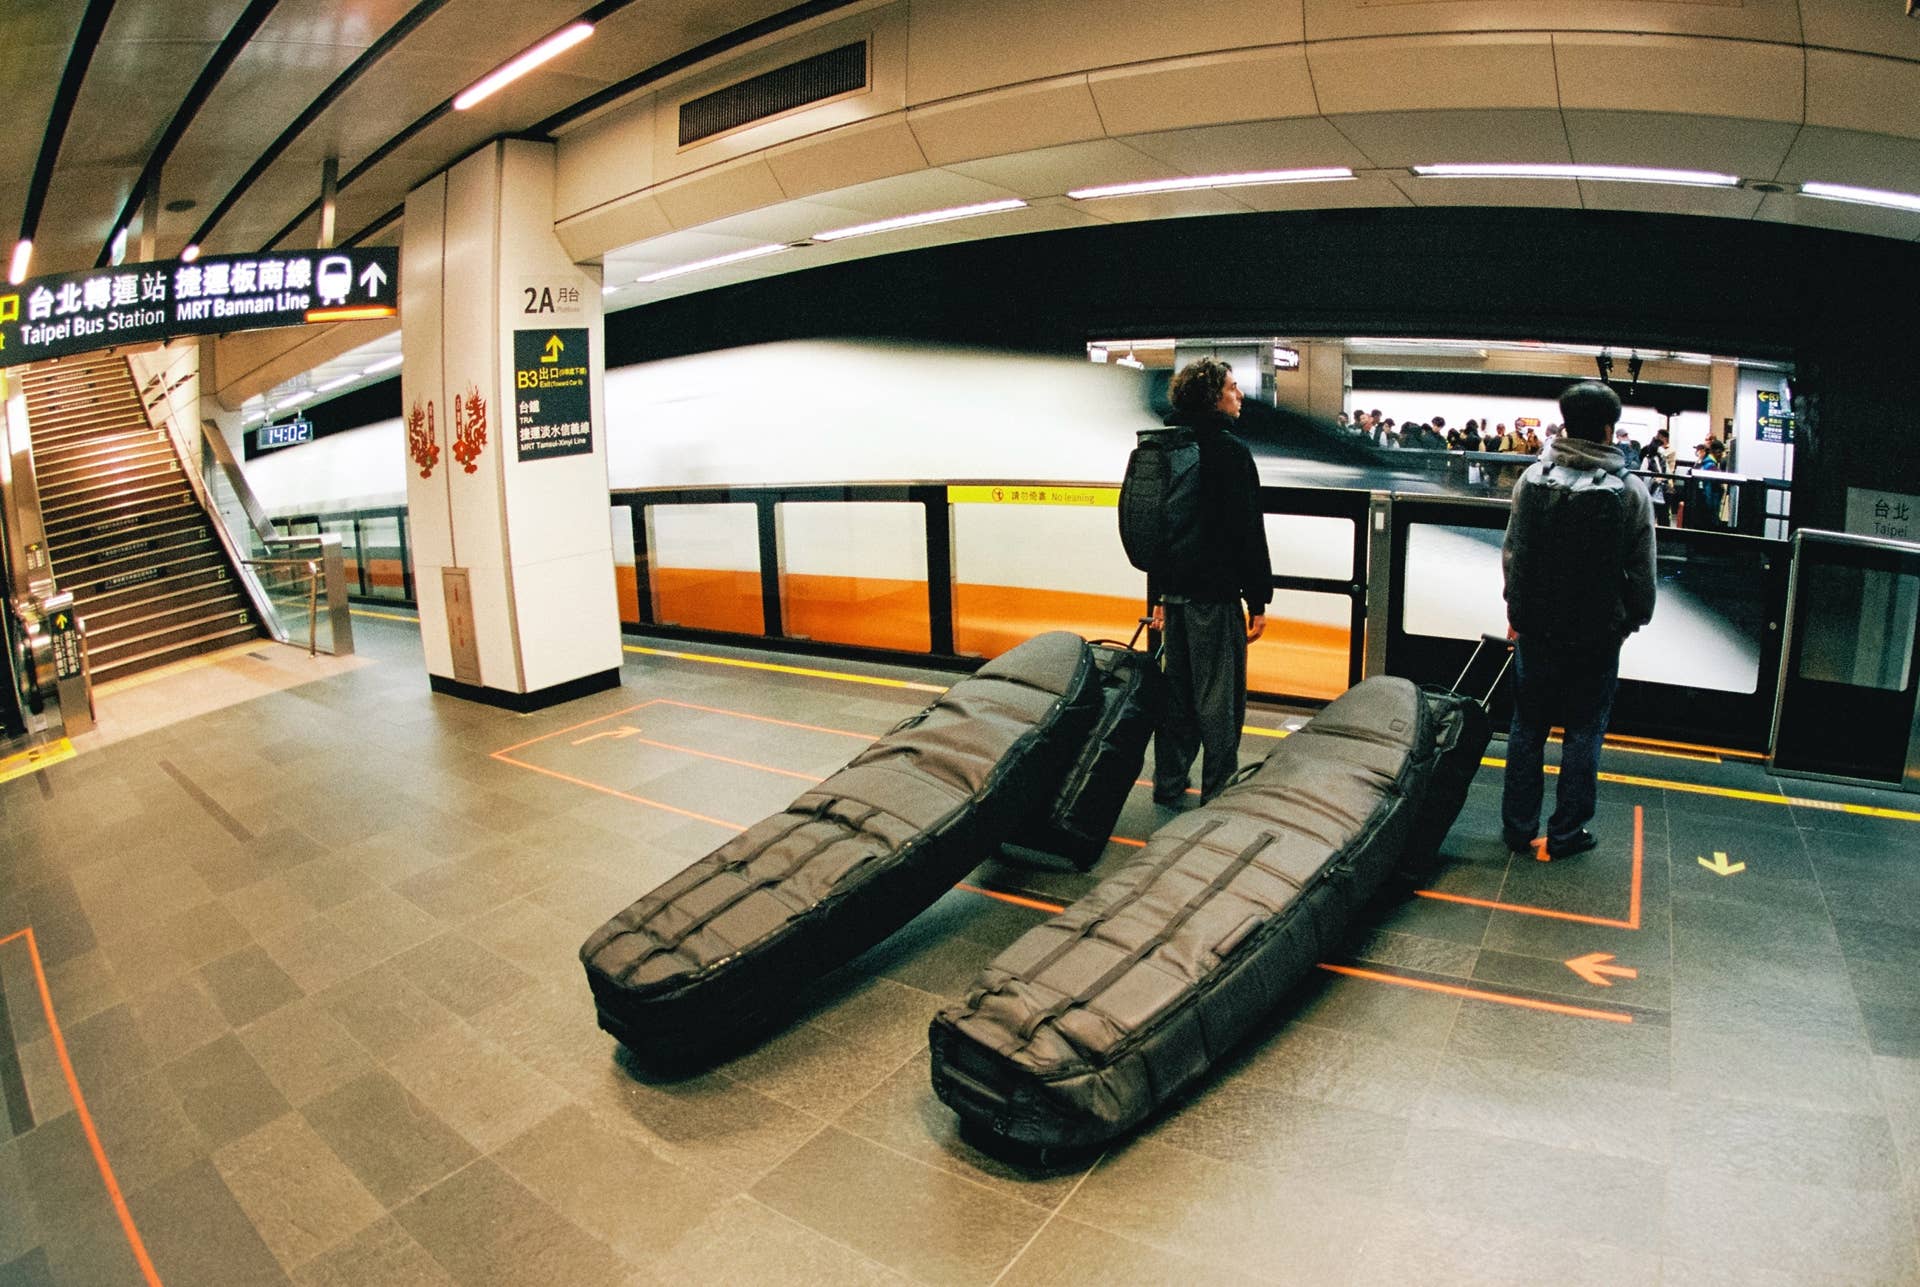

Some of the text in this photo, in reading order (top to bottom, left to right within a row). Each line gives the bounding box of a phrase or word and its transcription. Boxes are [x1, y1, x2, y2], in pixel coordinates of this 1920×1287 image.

[174, 258, 311, 299] 捷運板南線
[28, 270, 168, 320] 台北轉運站
[524, 286, 555, 314] 2A
[557, 287, 581, 303] 月台
[176, 292, 310, 321] MRT Bannan Line
[20, 318, 71, 346] Taipei
[73, 315, 104, 337] Bus
[107, 307, 165, 332] Station
[517, 370, 539, 389] B3
[519, 416, 534, 425] TRA
[269, 424, 308, 444] 14:02
[520, 441, 535, 451] MRT
[1051, 492, 1095, 505] No leaning
[1874, 498, 1910, 522] 台北
[1874, 521, 1908, 538] Taipei
